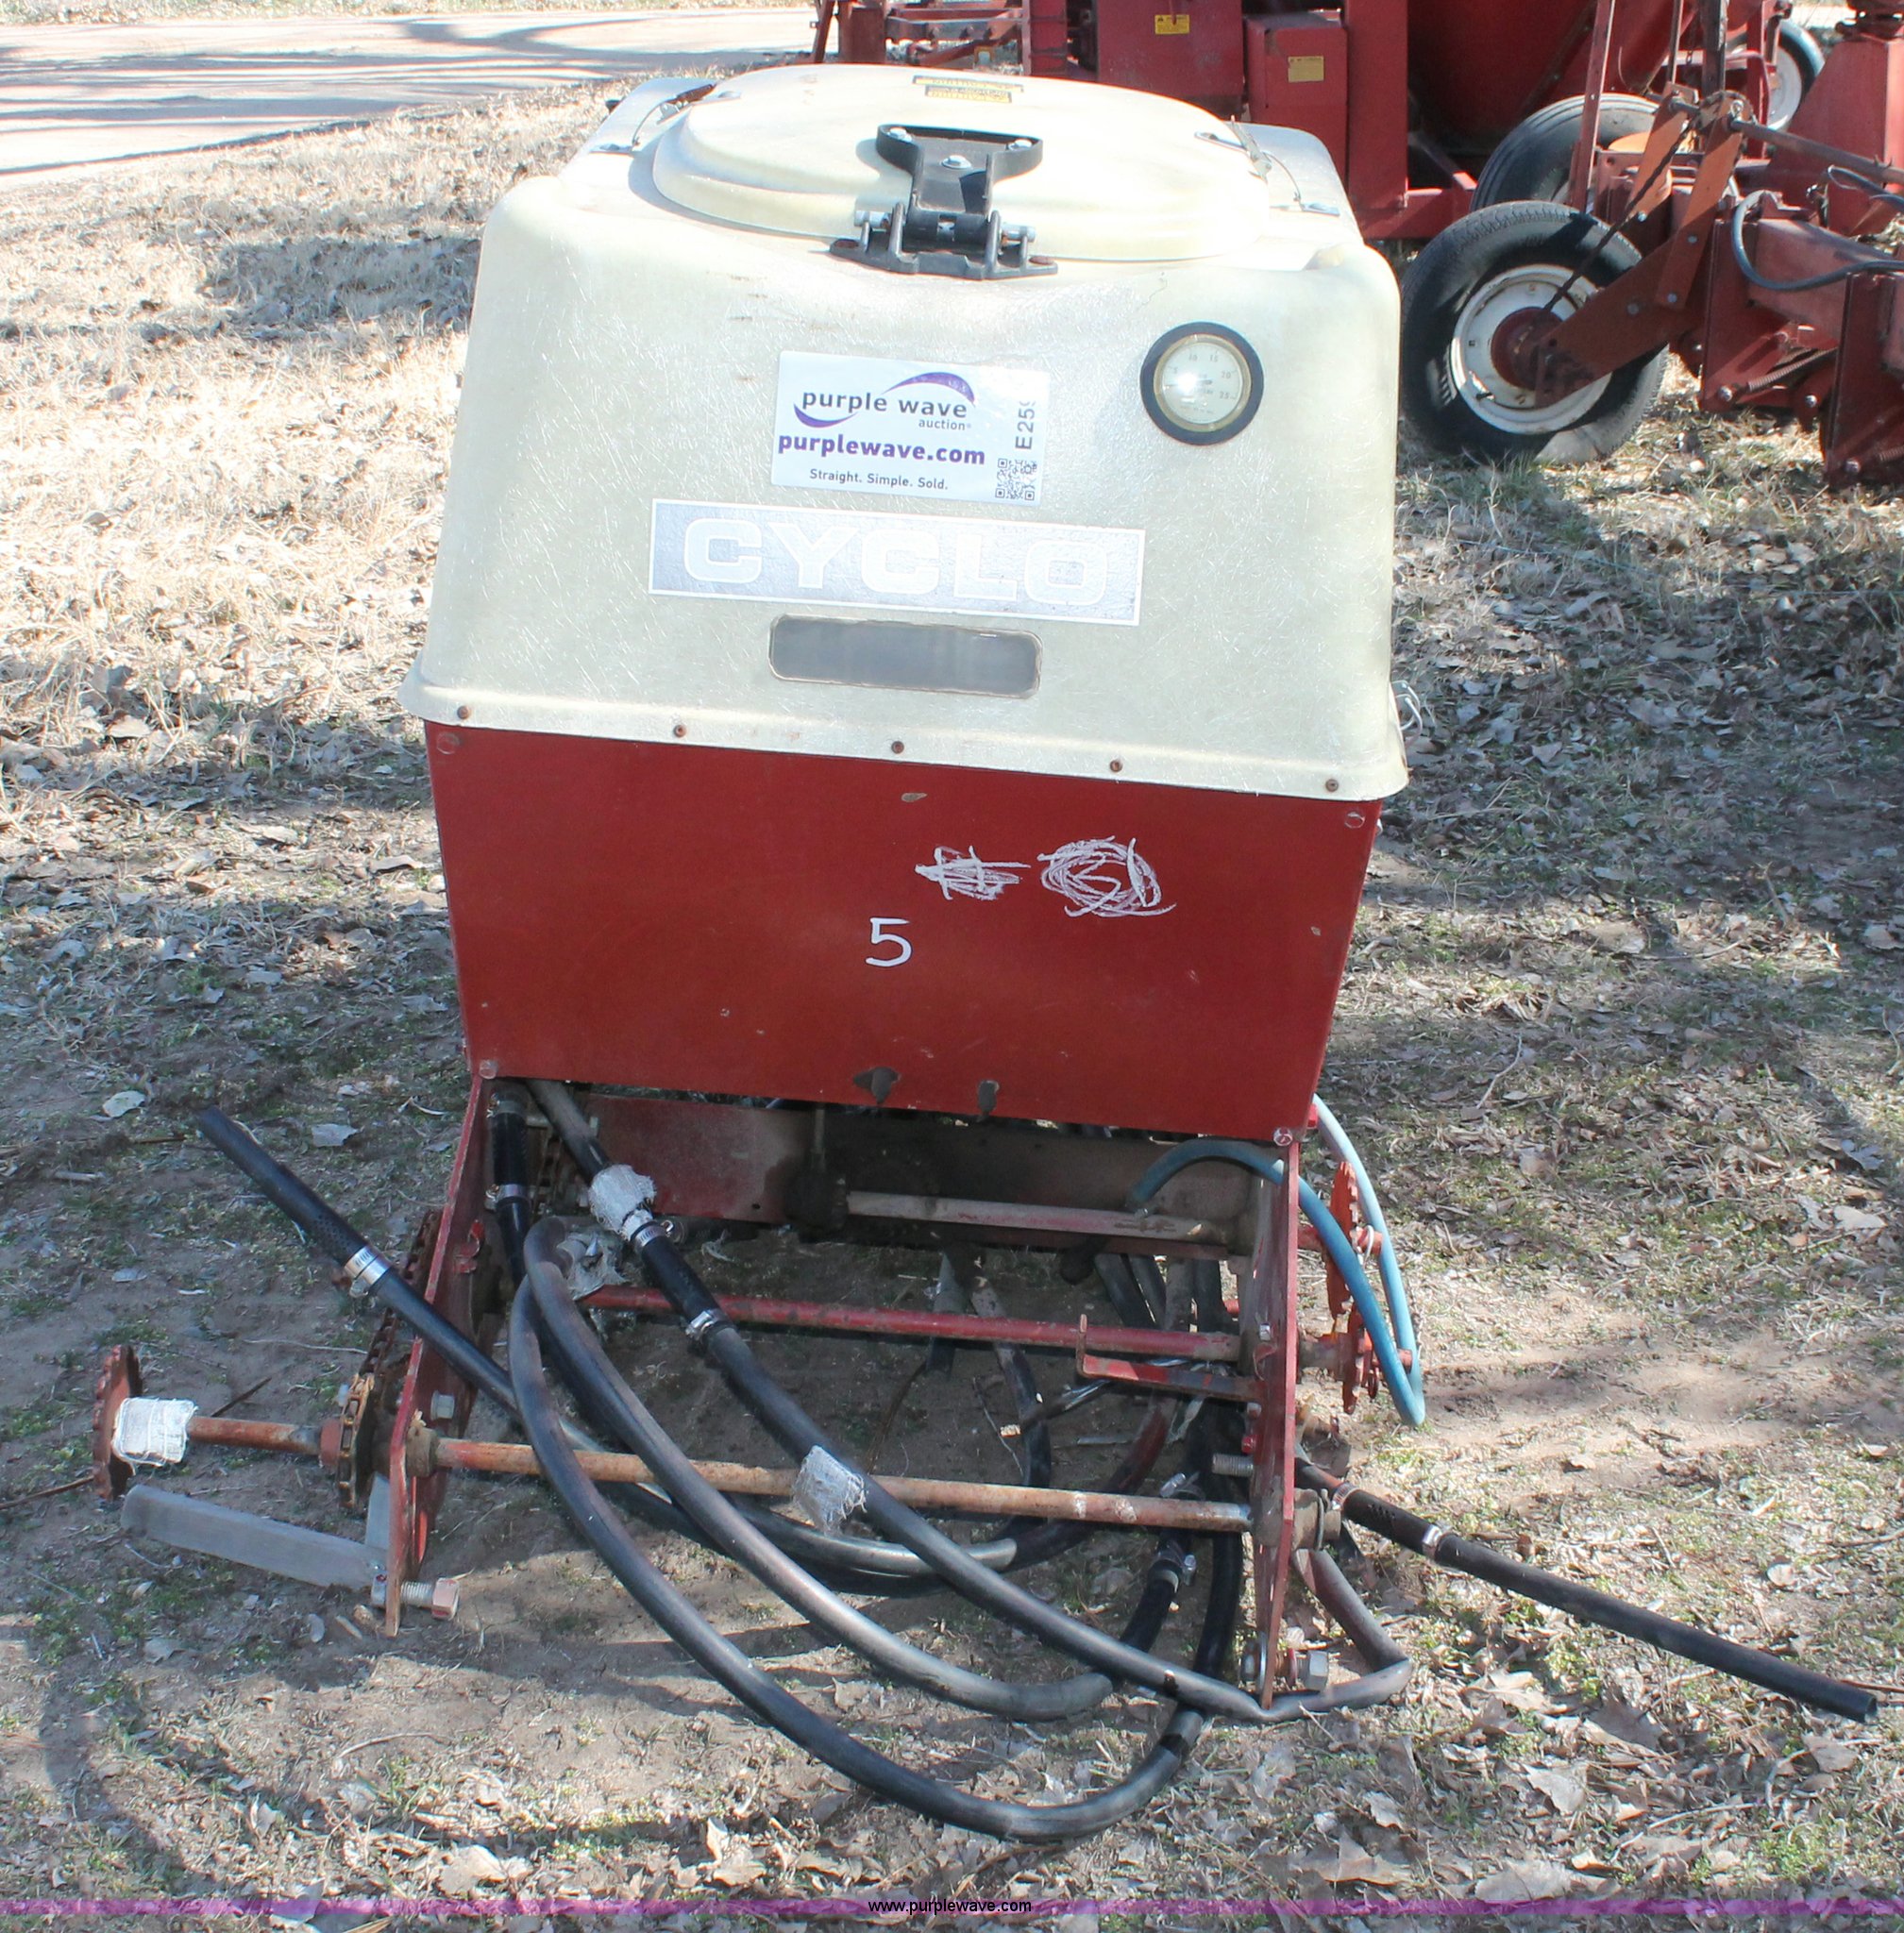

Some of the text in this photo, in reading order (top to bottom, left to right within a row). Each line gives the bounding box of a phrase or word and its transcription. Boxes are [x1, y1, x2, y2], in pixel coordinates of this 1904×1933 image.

[801, 391, 968, 418] purple wave
[778, 434, 986, 465] purplewave.com
[809, 468, 949, 490] Straight. Simple. Sold.
[683, 517, 1107, 606] CYCLO
[866, 917, 912, 967] 5
